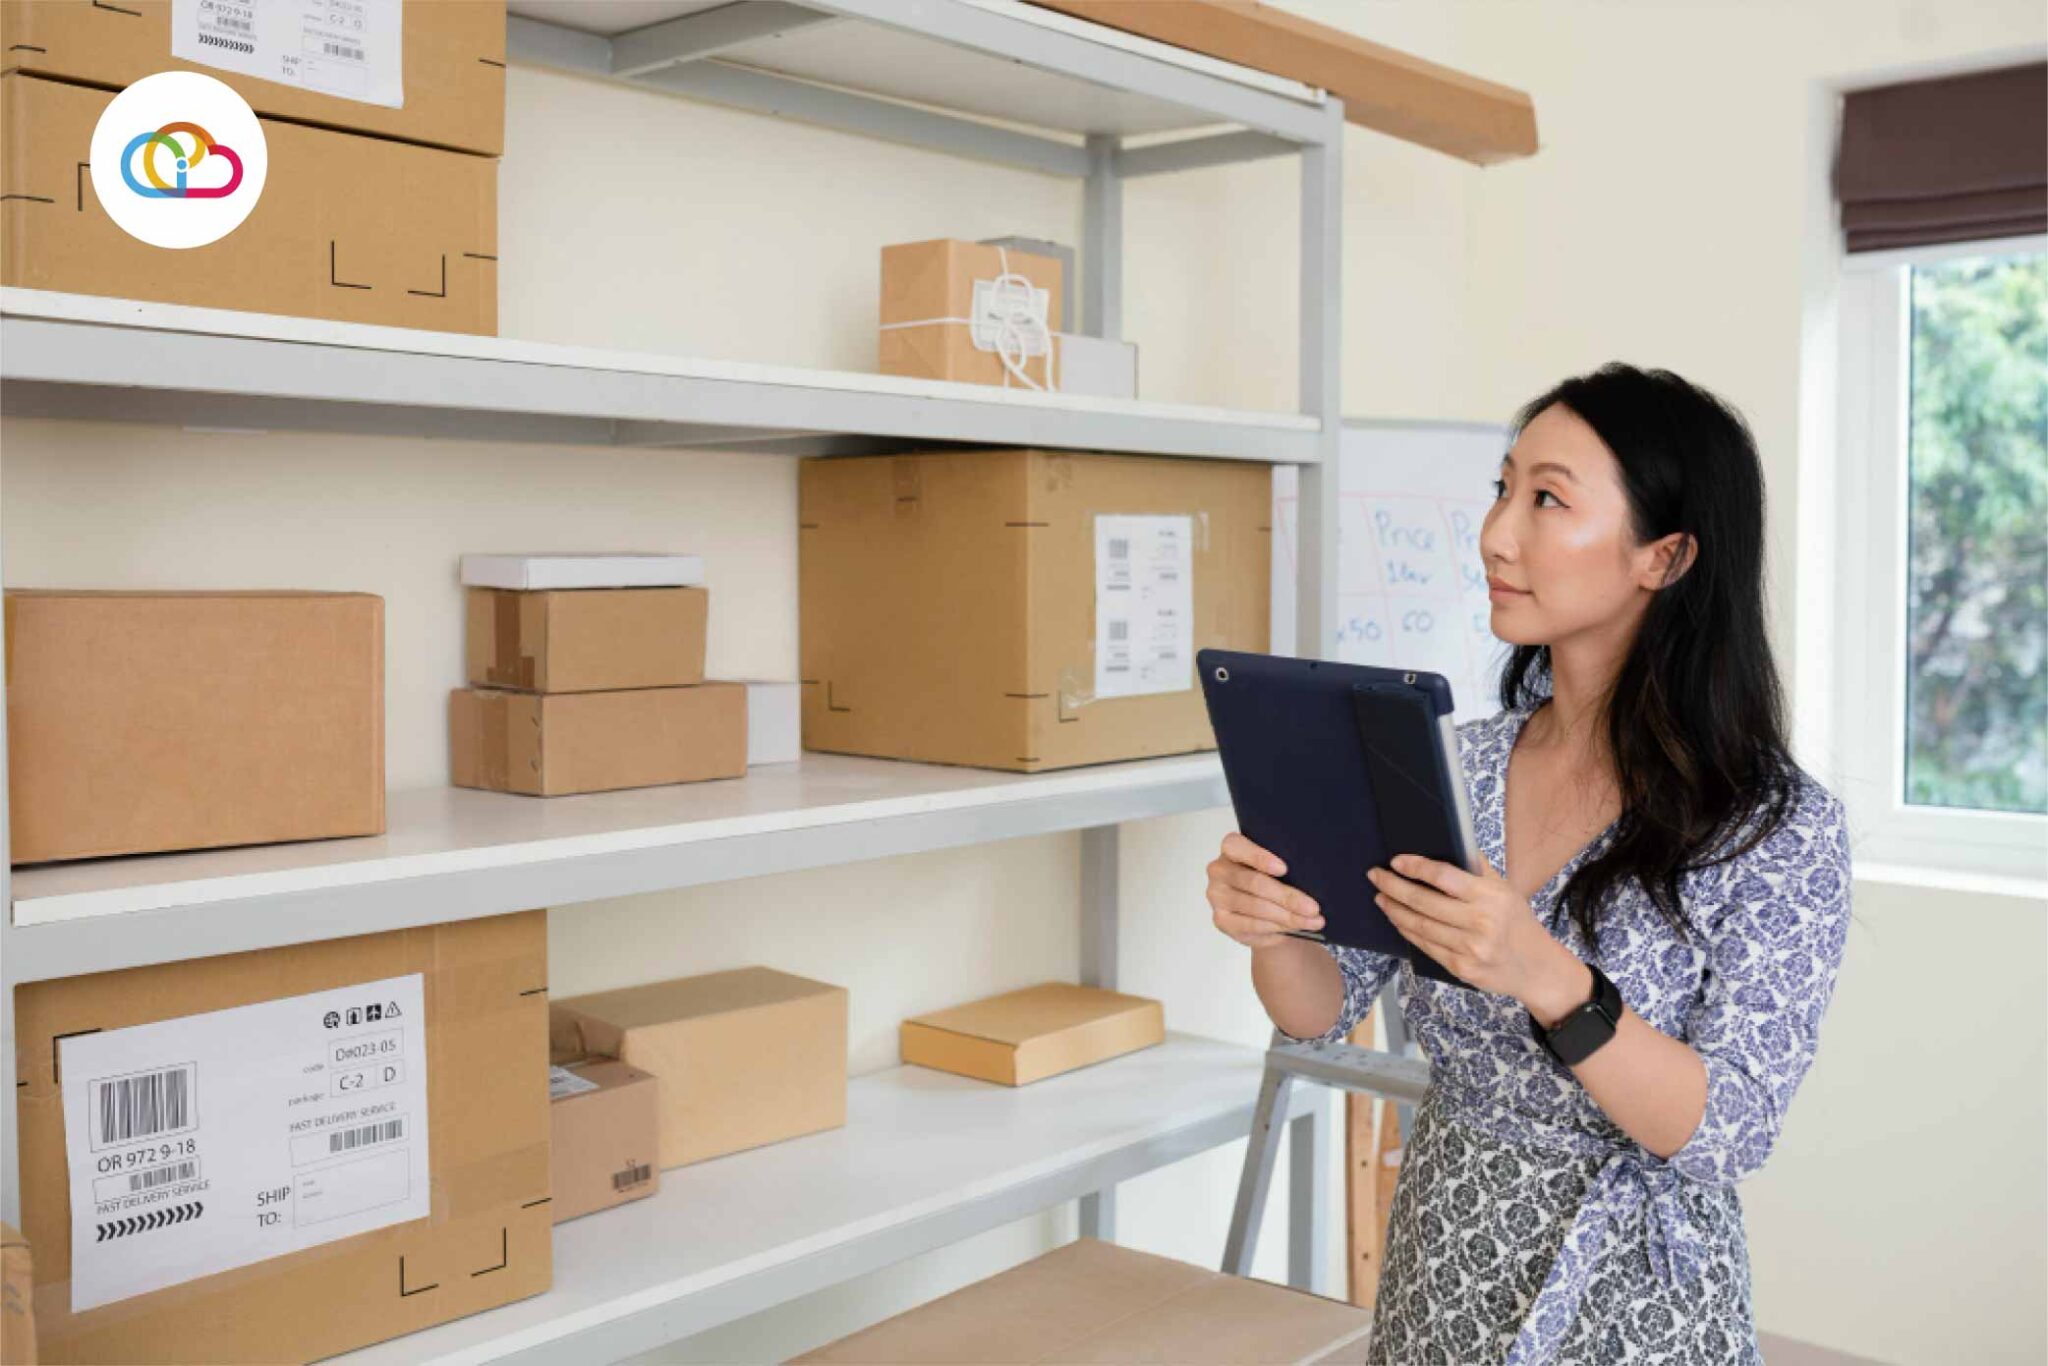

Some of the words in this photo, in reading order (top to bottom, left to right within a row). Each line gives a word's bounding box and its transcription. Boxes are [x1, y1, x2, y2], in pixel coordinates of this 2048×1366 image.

[339, 1073, 364, 1090] C-2
[384, 1066, 397, 1082] D
[97, 1154, 122, 1173] OR
[126, 1148, 157, 1168] 972
[160, 1137, 196, 1160] 9-18
[257, 1185, 292, 1207] SHIP
[256, 1211, 282, 1228] TO:
